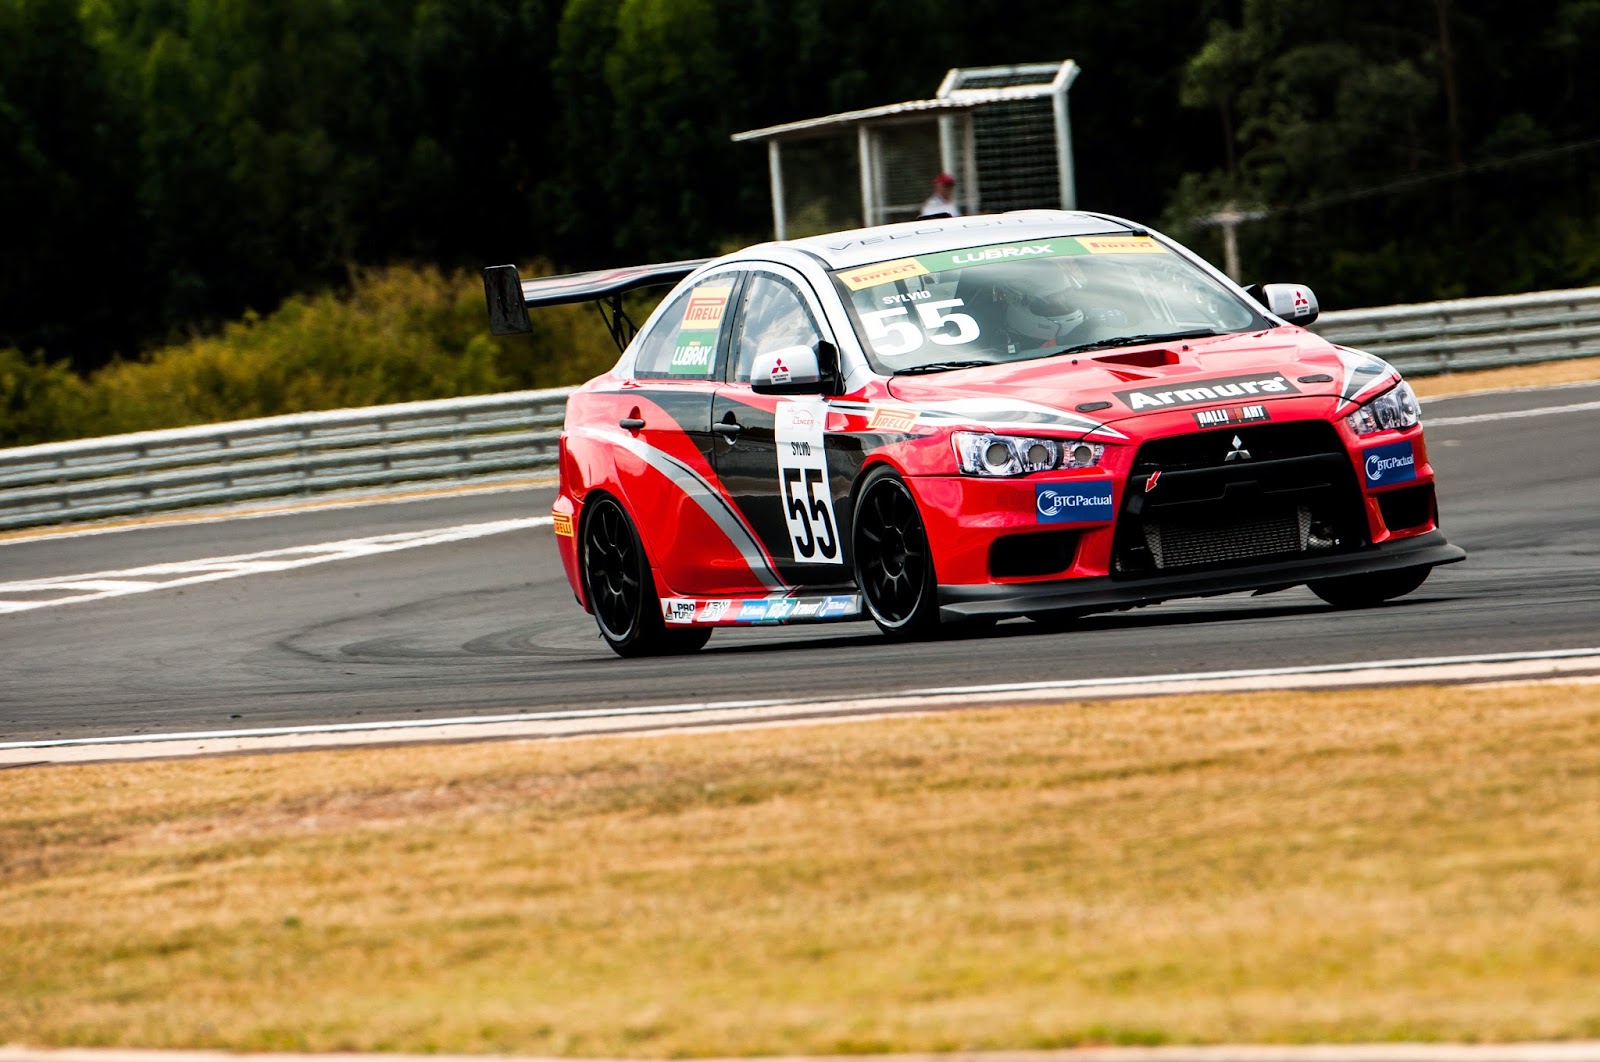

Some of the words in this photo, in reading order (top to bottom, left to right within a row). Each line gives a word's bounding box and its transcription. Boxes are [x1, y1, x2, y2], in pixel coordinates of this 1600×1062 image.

[827, 227, 943, 251] VELO
[952, 244, 1054, 264] LUBRAX
[851, 264, 916, 283] PIRELLI
[882, 290, 931, 305] SYLVIO
[685, 297, 727, 321] PIRELLI
[858, 298, 981, 356] 55
[672, 345, 713, 366] LUBRAX
[1127, 376, 1289, 410] Armura
[871, 408, 916, 429] PIRELLI
[791, 441, 811, 456] SYLVIO
[783, 468, 837, 559] 55
[677, 603, 695, 612] PRO
